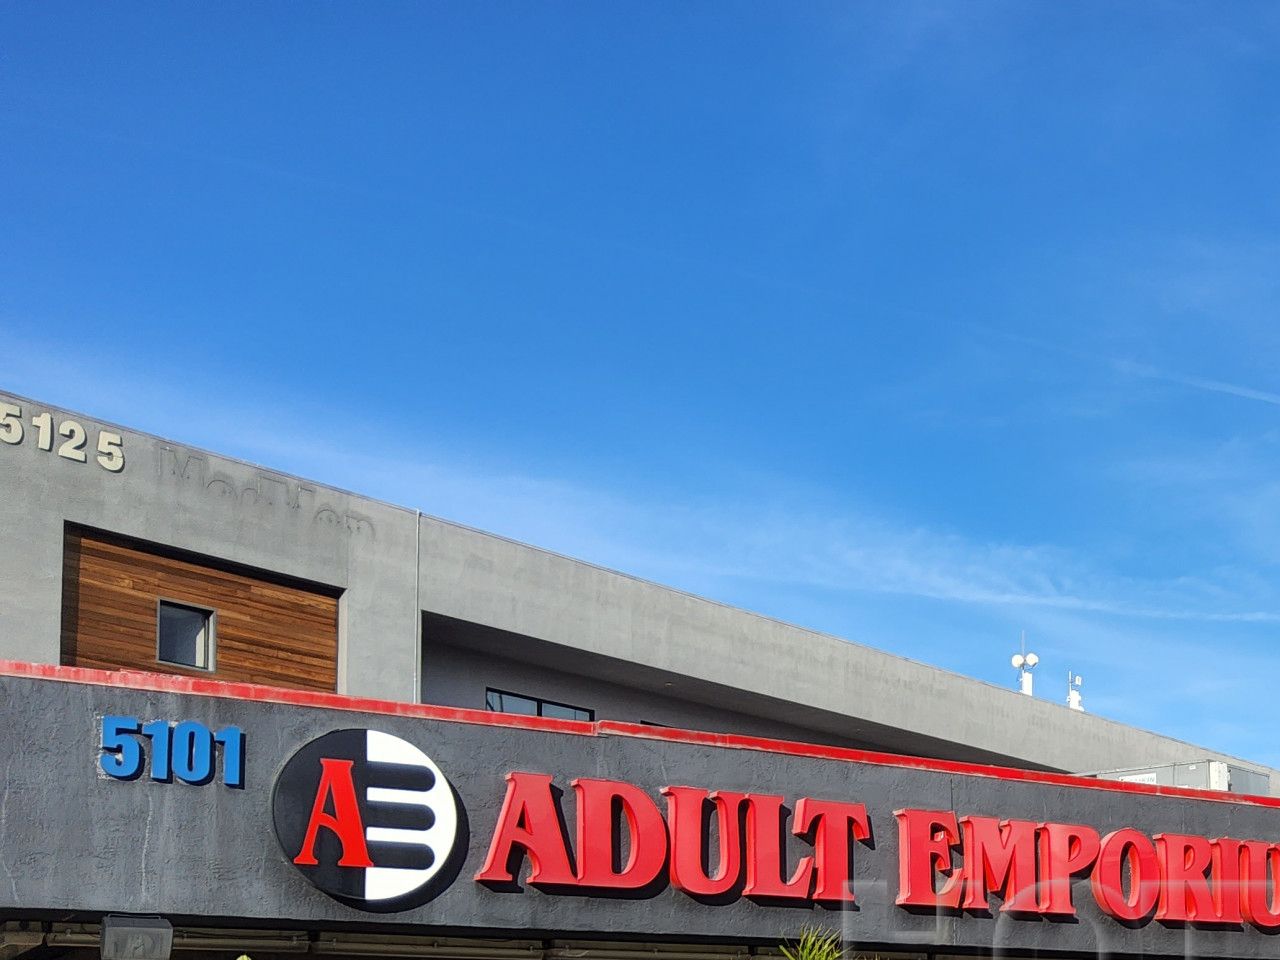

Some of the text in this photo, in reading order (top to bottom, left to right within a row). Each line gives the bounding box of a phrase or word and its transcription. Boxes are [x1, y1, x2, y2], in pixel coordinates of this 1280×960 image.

[0, 401, 125, 472] 5125
[100, 714, 243, 786] 5101
[474, 771, 870, 902] ADULT
